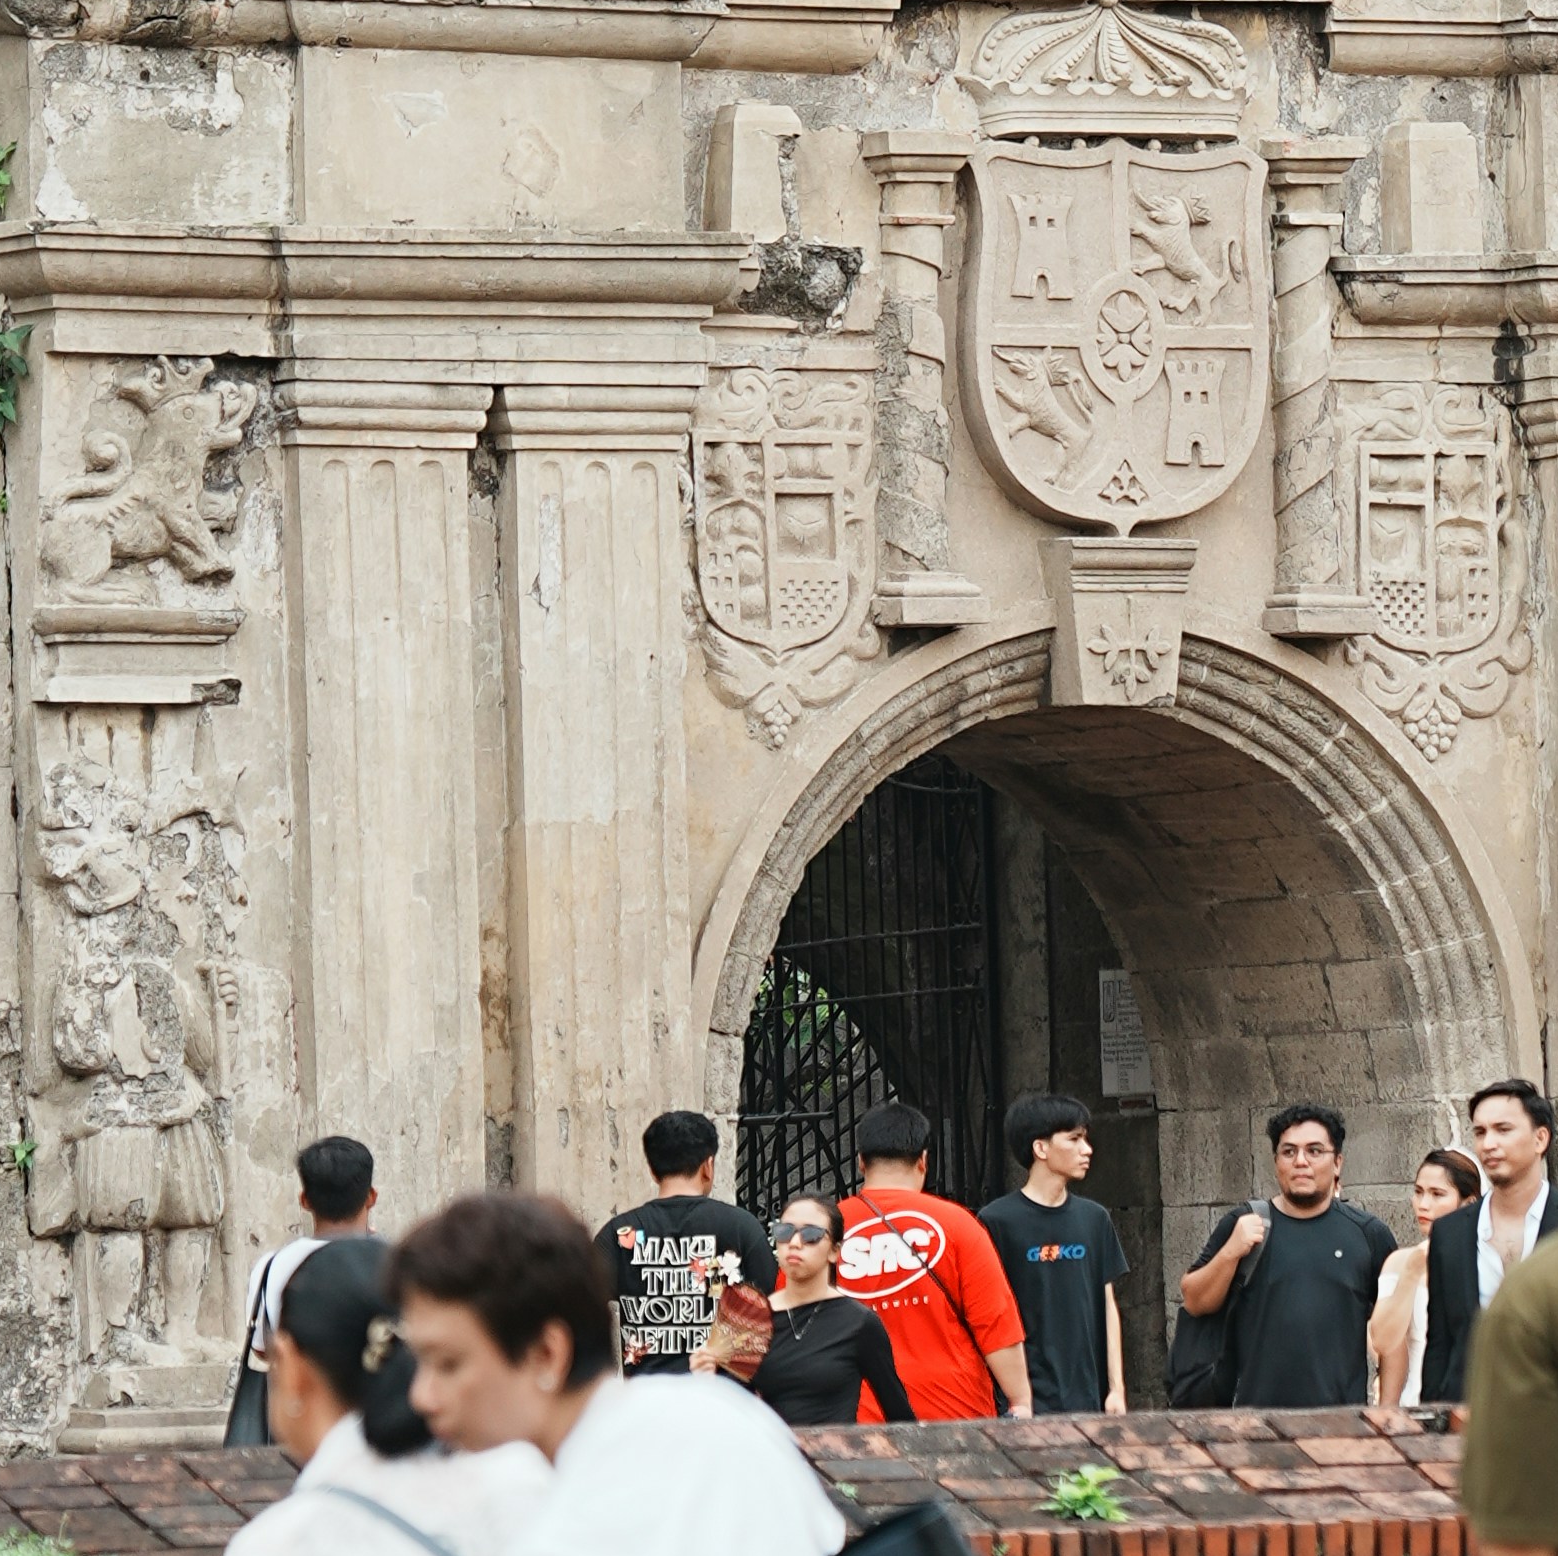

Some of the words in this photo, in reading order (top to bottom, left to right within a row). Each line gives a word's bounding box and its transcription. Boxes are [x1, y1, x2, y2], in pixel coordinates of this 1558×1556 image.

[630, 1234, 717, 1265] MAKE
[641, 1267, 707, 1296] THE
[619, 1295, 720, 1324] WORL
